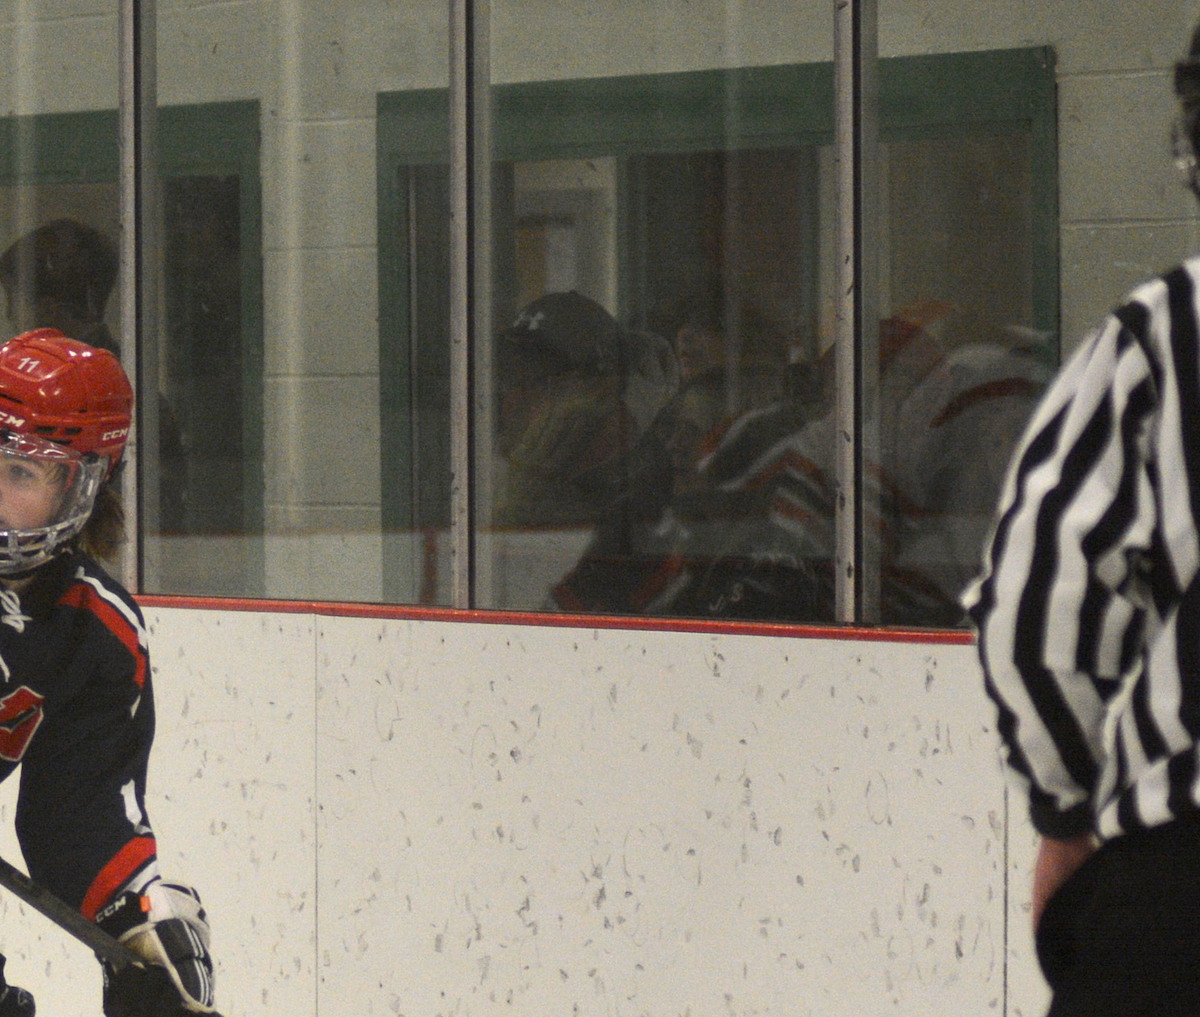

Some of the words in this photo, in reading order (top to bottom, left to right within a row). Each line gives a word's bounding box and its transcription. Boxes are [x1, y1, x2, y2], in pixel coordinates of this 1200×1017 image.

[19, 357, 40, 373] 11
[102, 427, 129, 441] CCM
[96, 895, 127, 923] CCM
